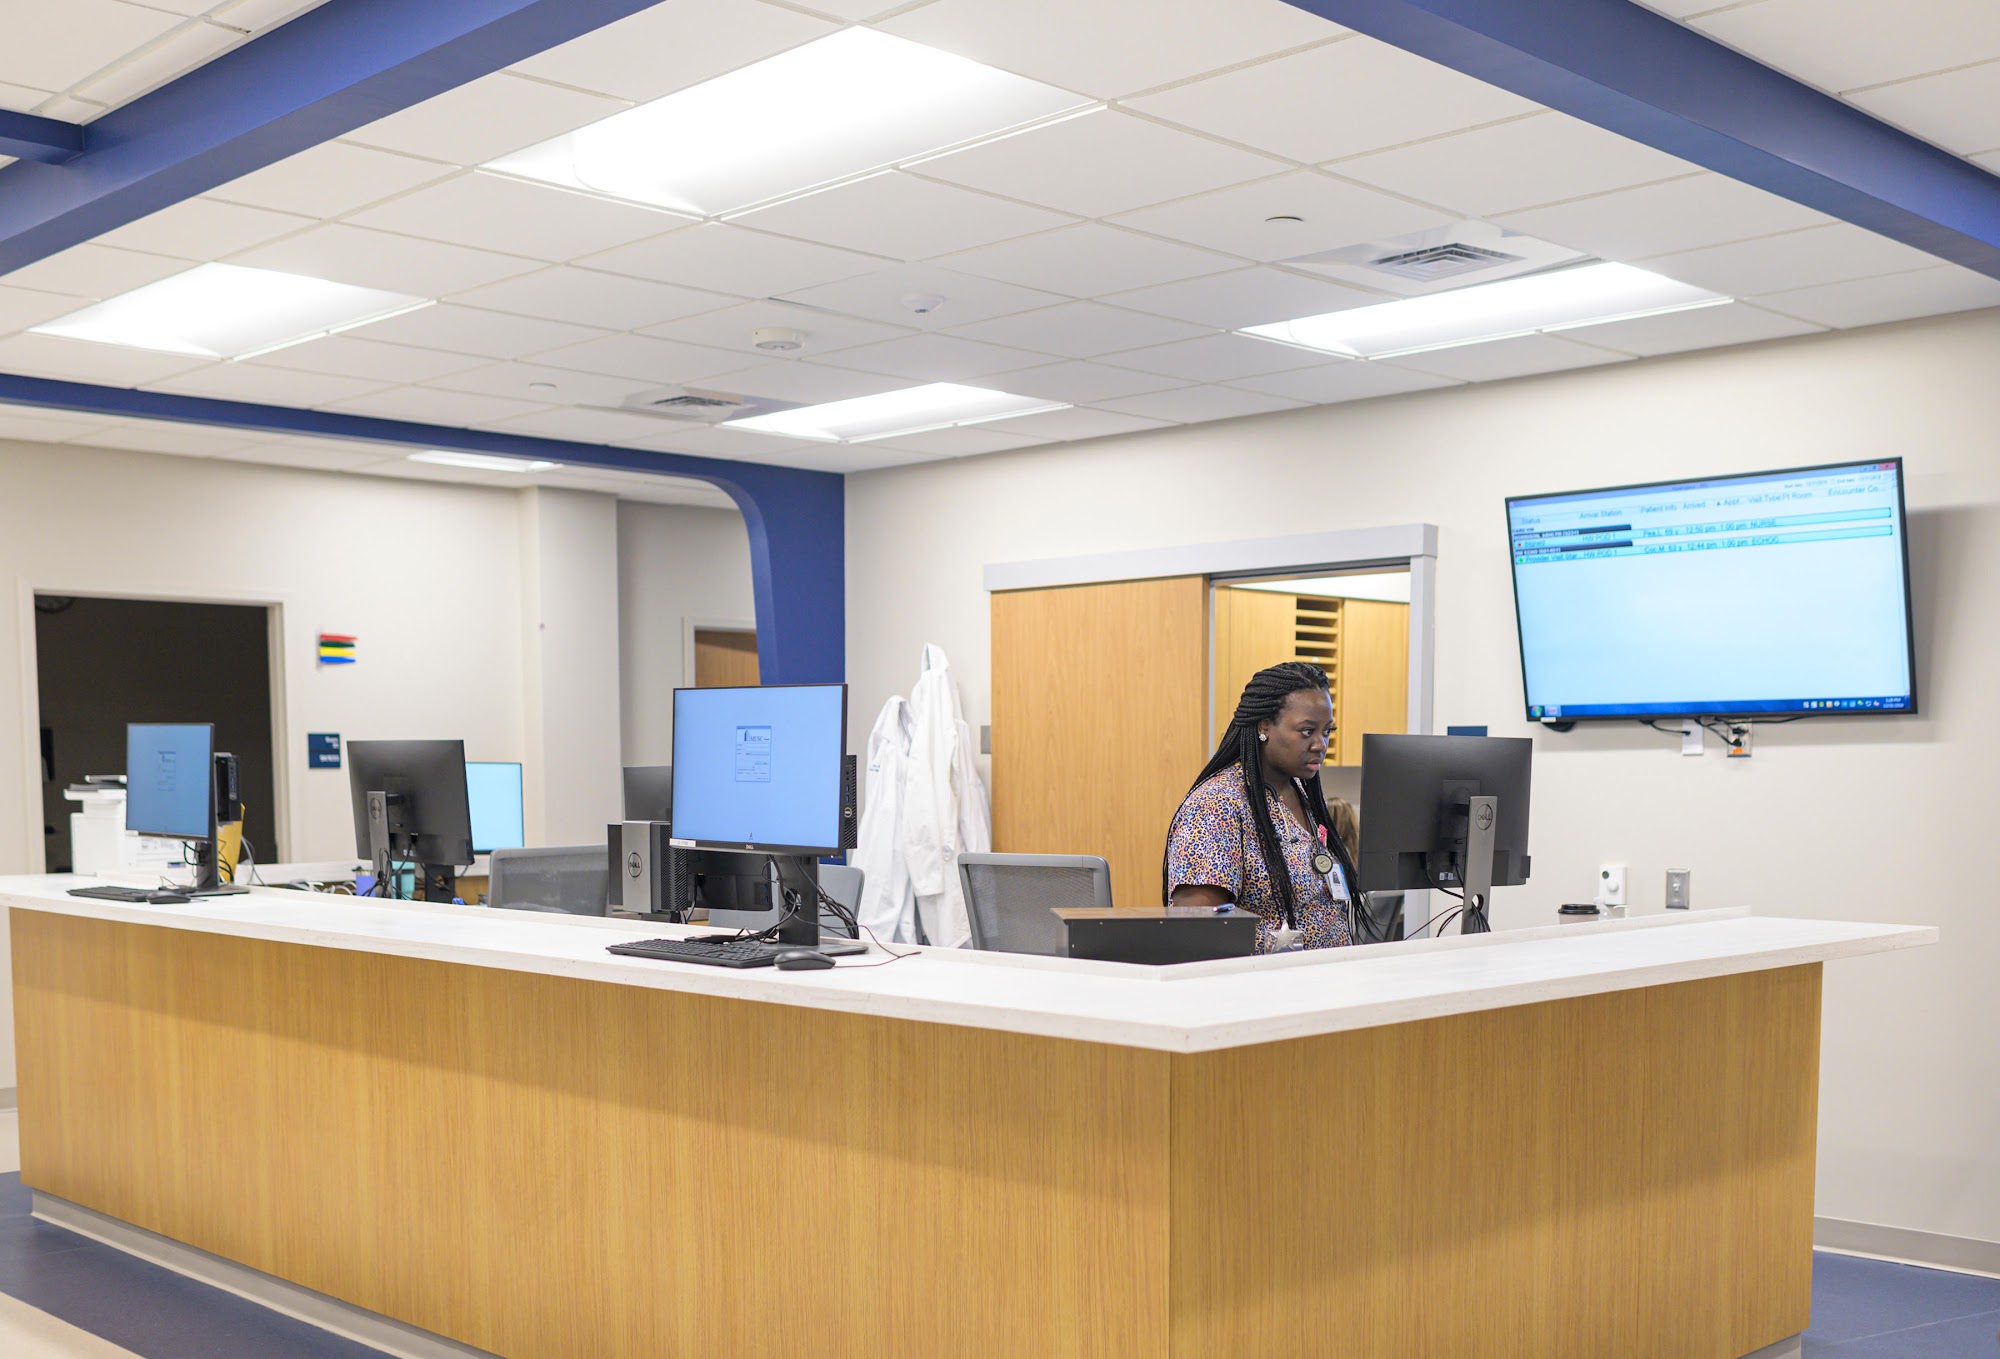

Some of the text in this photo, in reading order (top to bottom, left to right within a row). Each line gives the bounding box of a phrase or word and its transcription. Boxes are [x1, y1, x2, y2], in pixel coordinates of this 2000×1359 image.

[1828, 487, 1865, 496] Encounter
[1640, 504, 1663, 513] Patient
[1579, 509, 1622, 519] Arrival Station
[1521, 516, 1541, 524] Status
